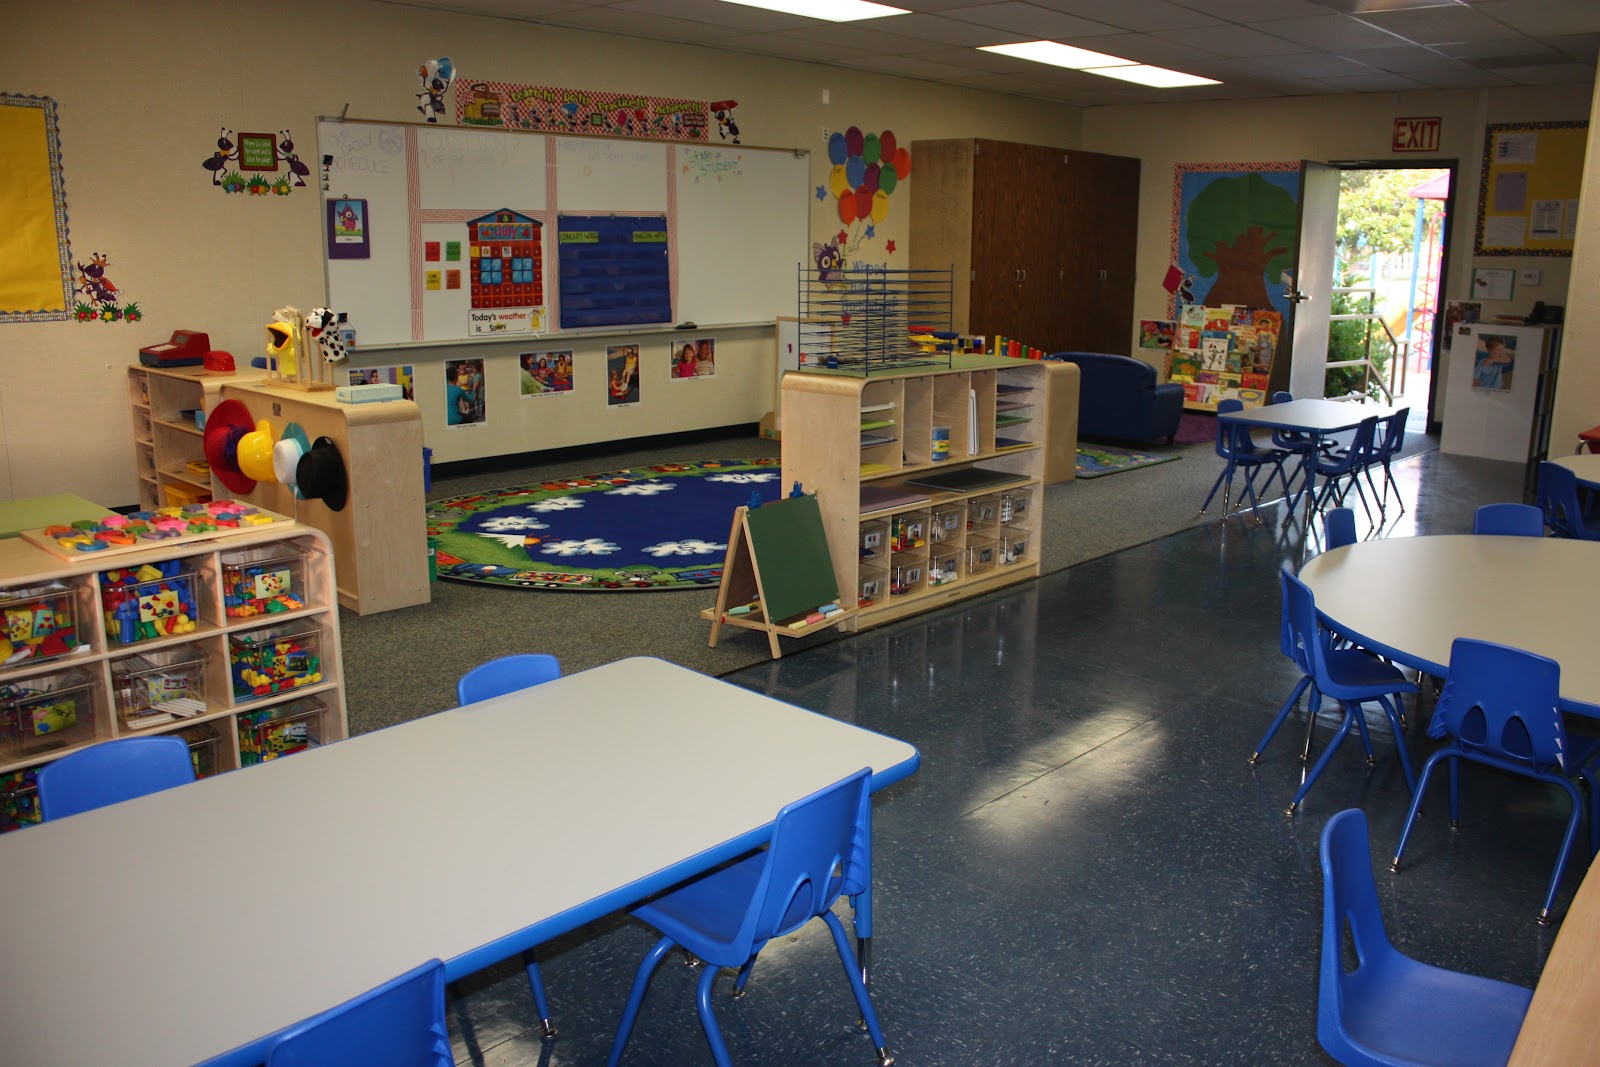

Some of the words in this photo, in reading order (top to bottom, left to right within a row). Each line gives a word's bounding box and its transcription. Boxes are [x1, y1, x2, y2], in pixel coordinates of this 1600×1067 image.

[510, 88, 541, 102] Learn
[543, 90, 556, 104] It!
[563, 92, 576, 102] Do
[578, 93, 591, 107] It!
[598, 99, 634, 113] Practice
[636, 98, 649, 111] It!
[655, 104, 690, 115] Achieve
[692, 101, 703, 113] It!
[1395, 120, 1438, 148] EXIT
[700, 161, 739, 176] STUDENT
[494, 225, 518, 239] July
[471, 313, 497, 322] Today's
[498, 312, 527, 321] weather
[475, 324, 482, 332] is
